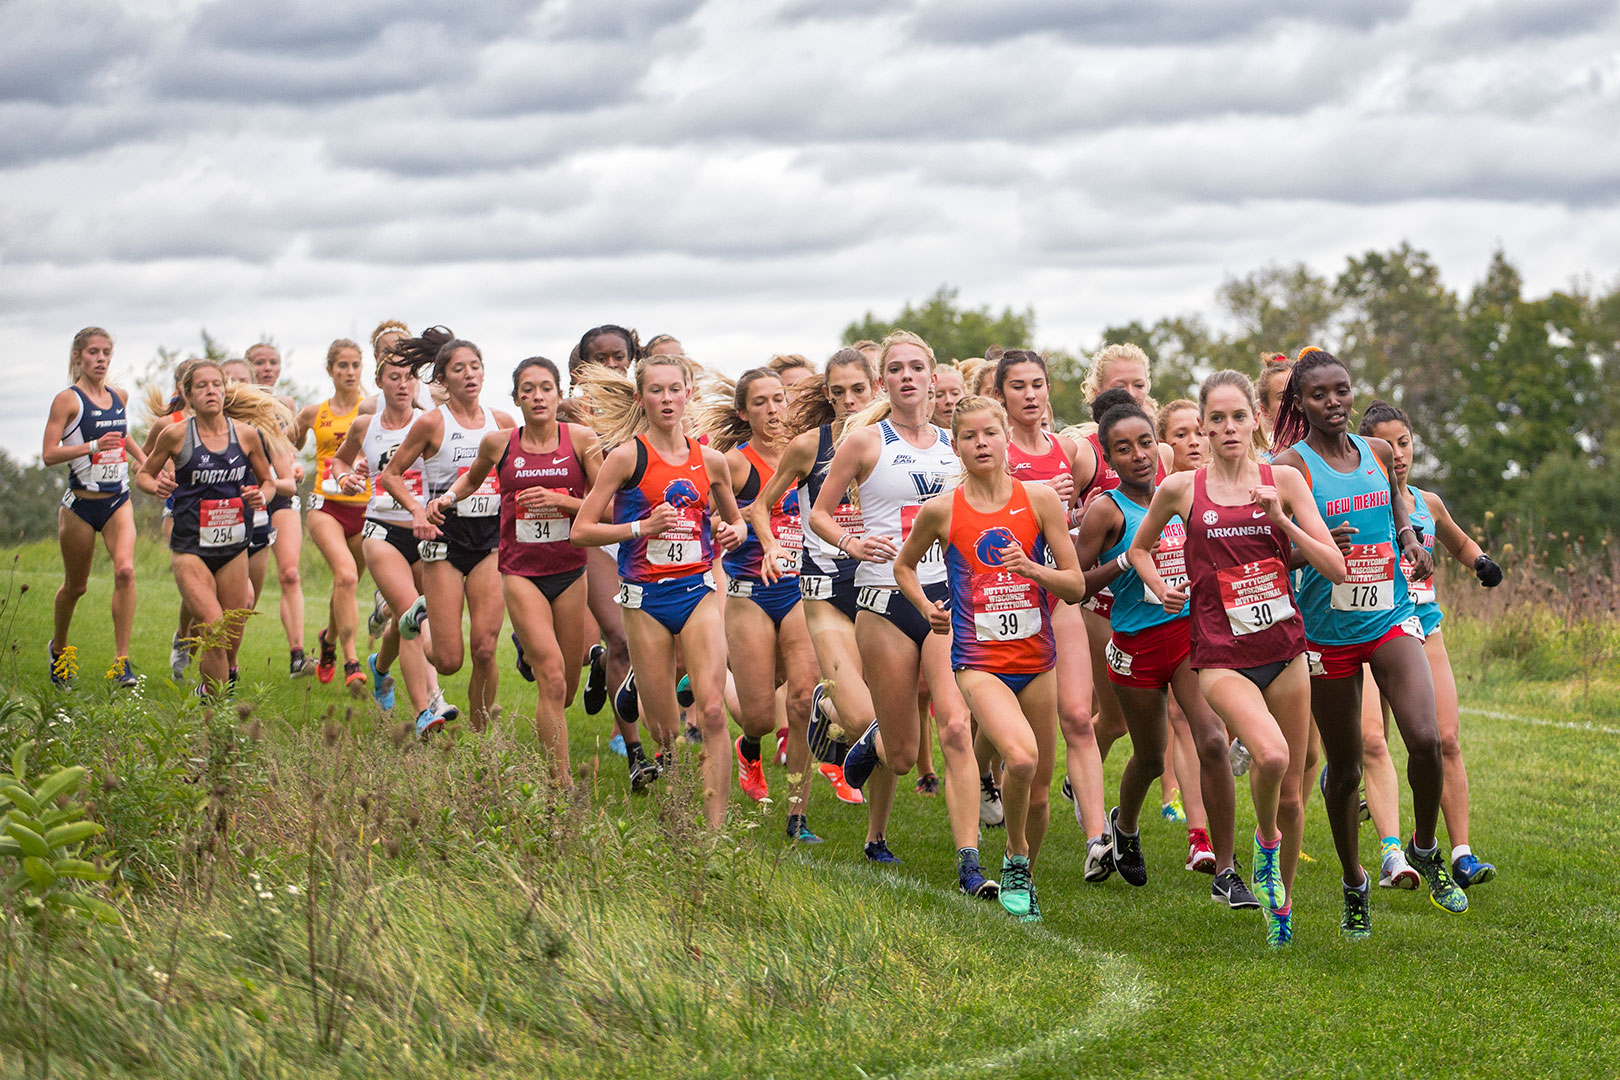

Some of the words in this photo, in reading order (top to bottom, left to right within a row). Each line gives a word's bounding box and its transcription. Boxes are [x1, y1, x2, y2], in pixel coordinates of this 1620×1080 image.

[515, 468, 569, 478] ARKANSAS
[1014, 462, 1031, 470] ACC
[471, 496, 489, 513] 267
[1326, 496, 1351, 517] NEW
[1353, 490, 1389, 512] MEXICO
[213, 527, 233, 543] 254
[534, 521, 550, 539] 34
[1206, 525, 1272, 539] ARKANSAS
[667, 543, 683, 562] 43
[1347, 556, 1390, 567] NUTTYCOMBE
[1344, 573, 1388, 582] INVITATIONAL
[1350, 565, 1385, 575] WISCONSIN
[1231, 571, 1278, 591] NUTTYCOMBE
[1237, 581, 1275, 597] WISCONSIN
[983, 583, 1031, 596] NUTTYCOMBE
[988, 592, 1025, 603] WISCONSIN
[1234, 588, 1283, 606] INVITATIONAL
[1350, 585, 1378, 607] 178
[984, 599, 1033, 611] INVITATIONAL
[1251, 603, 1273, 627] 30
[998, 613, 1018, 636] 39
